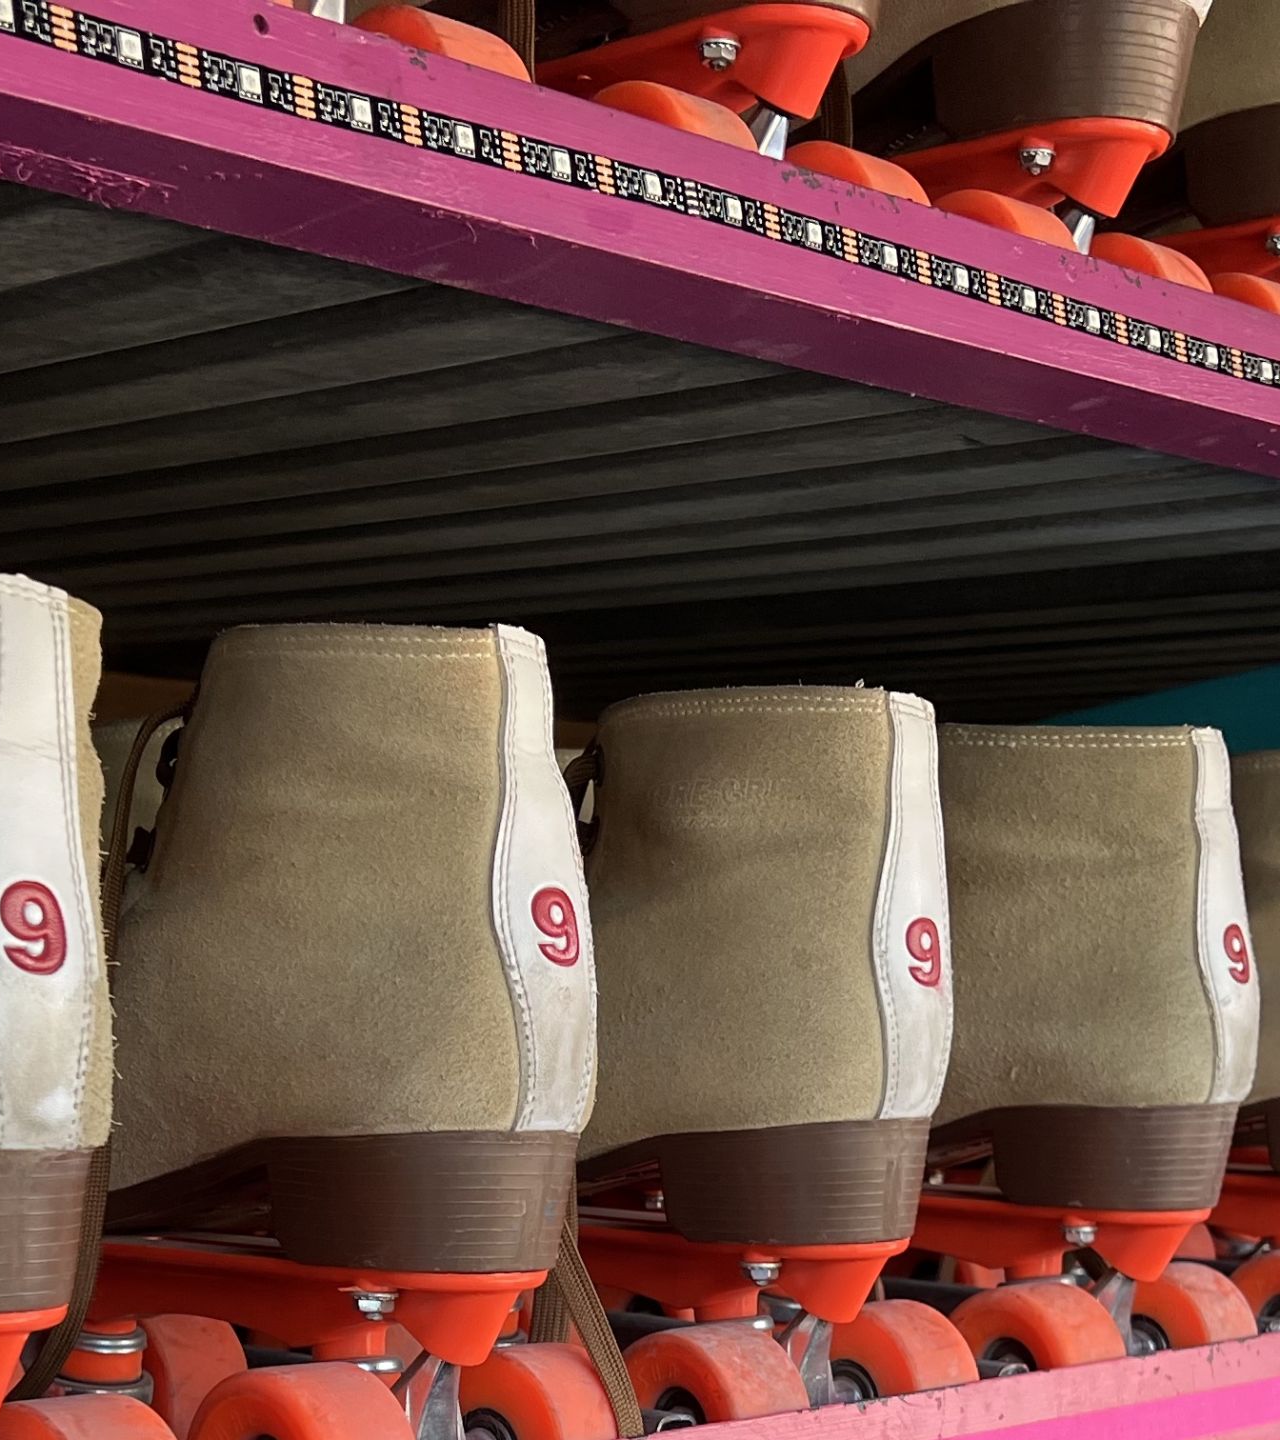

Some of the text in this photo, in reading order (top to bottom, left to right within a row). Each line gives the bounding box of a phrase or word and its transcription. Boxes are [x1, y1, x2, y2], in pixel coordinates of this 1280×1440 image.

[0, 880, 67, 975] 9
[532, 887, 580, 967] 9
[906, 917, 942, 991] 9
[1224, 923, 1251, 984] 9
